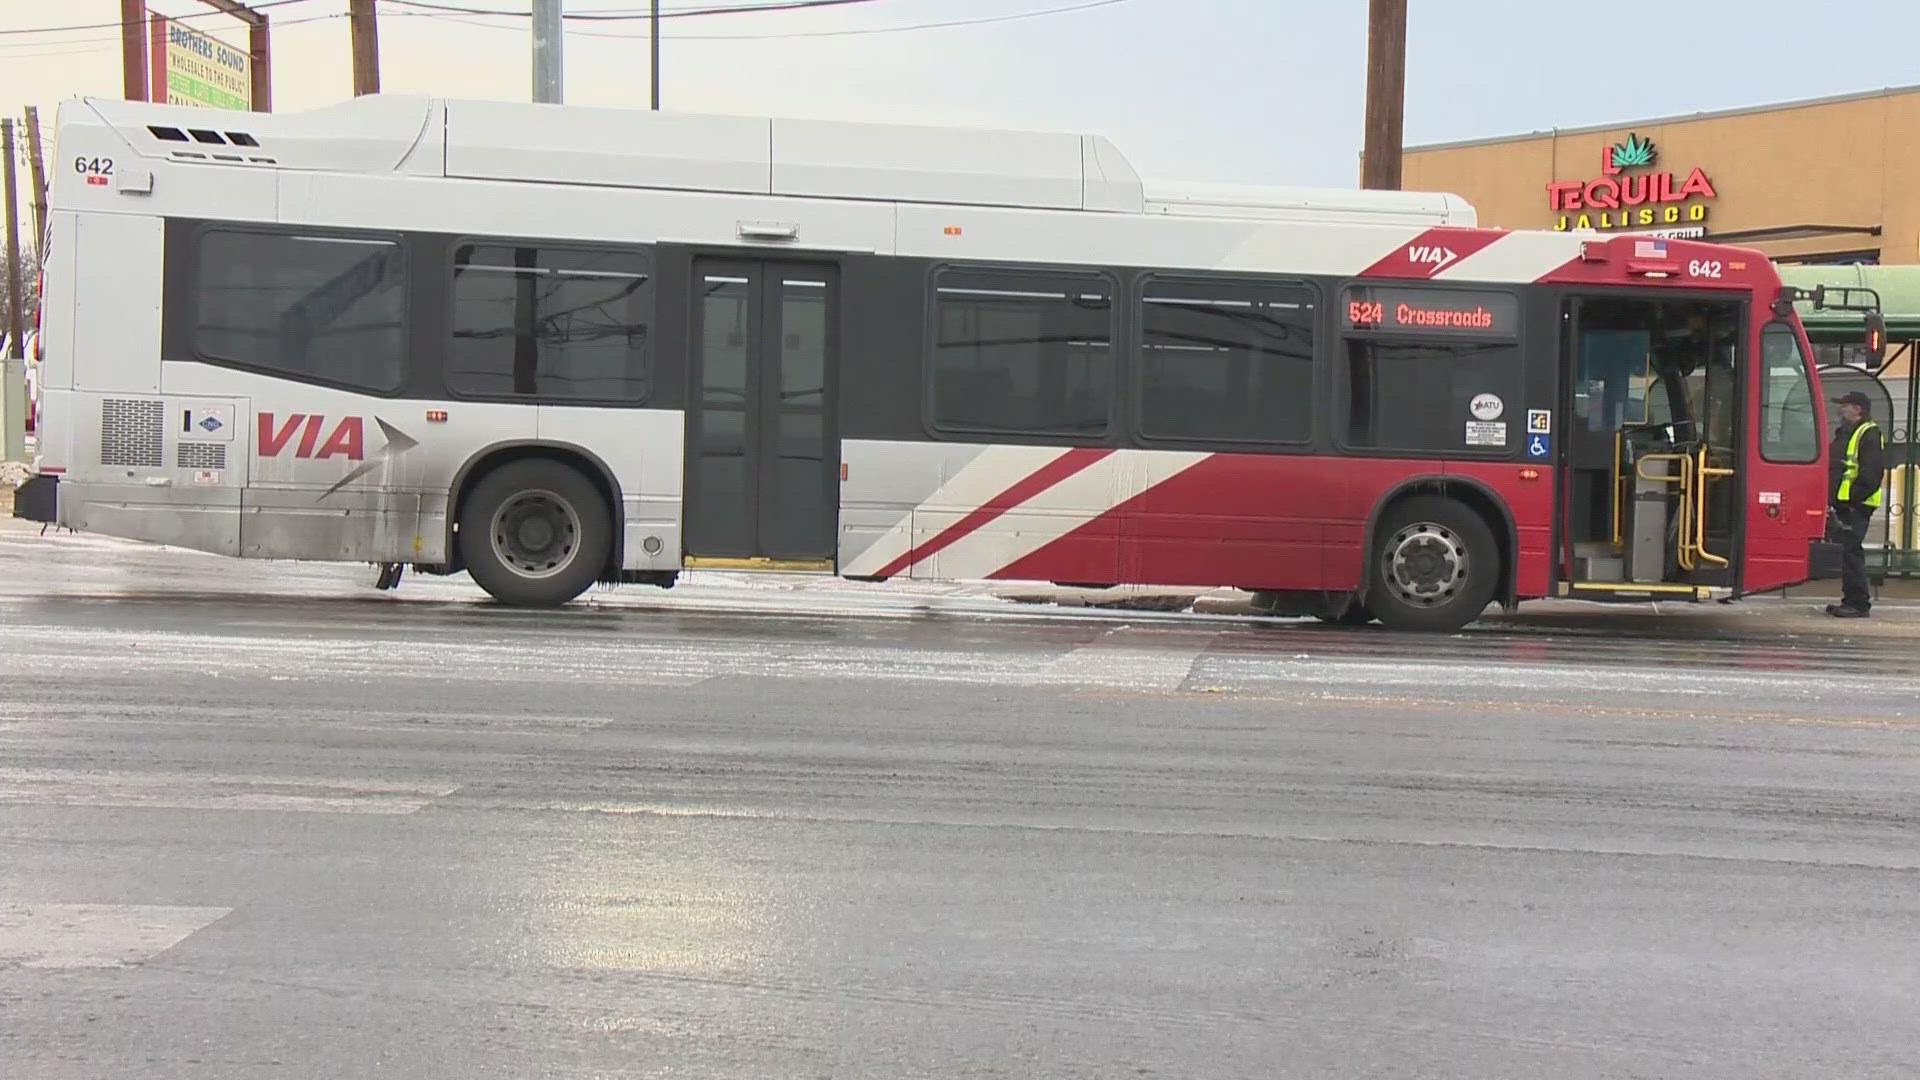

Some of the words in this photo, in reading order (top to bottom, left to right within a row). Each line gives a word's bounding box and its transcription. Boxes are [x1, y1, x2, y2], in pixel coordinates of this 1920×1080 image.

[170, 25, 213, 60] BROTHERS
[216, 46, 244, 73] SOUND
[205, 66, 213, 81] TO
[213, 69, 224, 87] THE
[74, 156, 114, 175] 642
[1546, 167, 1716, 211] TEQUILA
[1553, 204, 1706, 231] JALISCO
[1409, 246, 1443, 263] VIA
[1688, 260, 1722, 278] 642
[1350, 302, 1383, 323] 524
[1397, 304, 1492, 327] Crossroads
[1483, 402, 1500, 410] ATU
[257, 412, 364, 461] VIA
